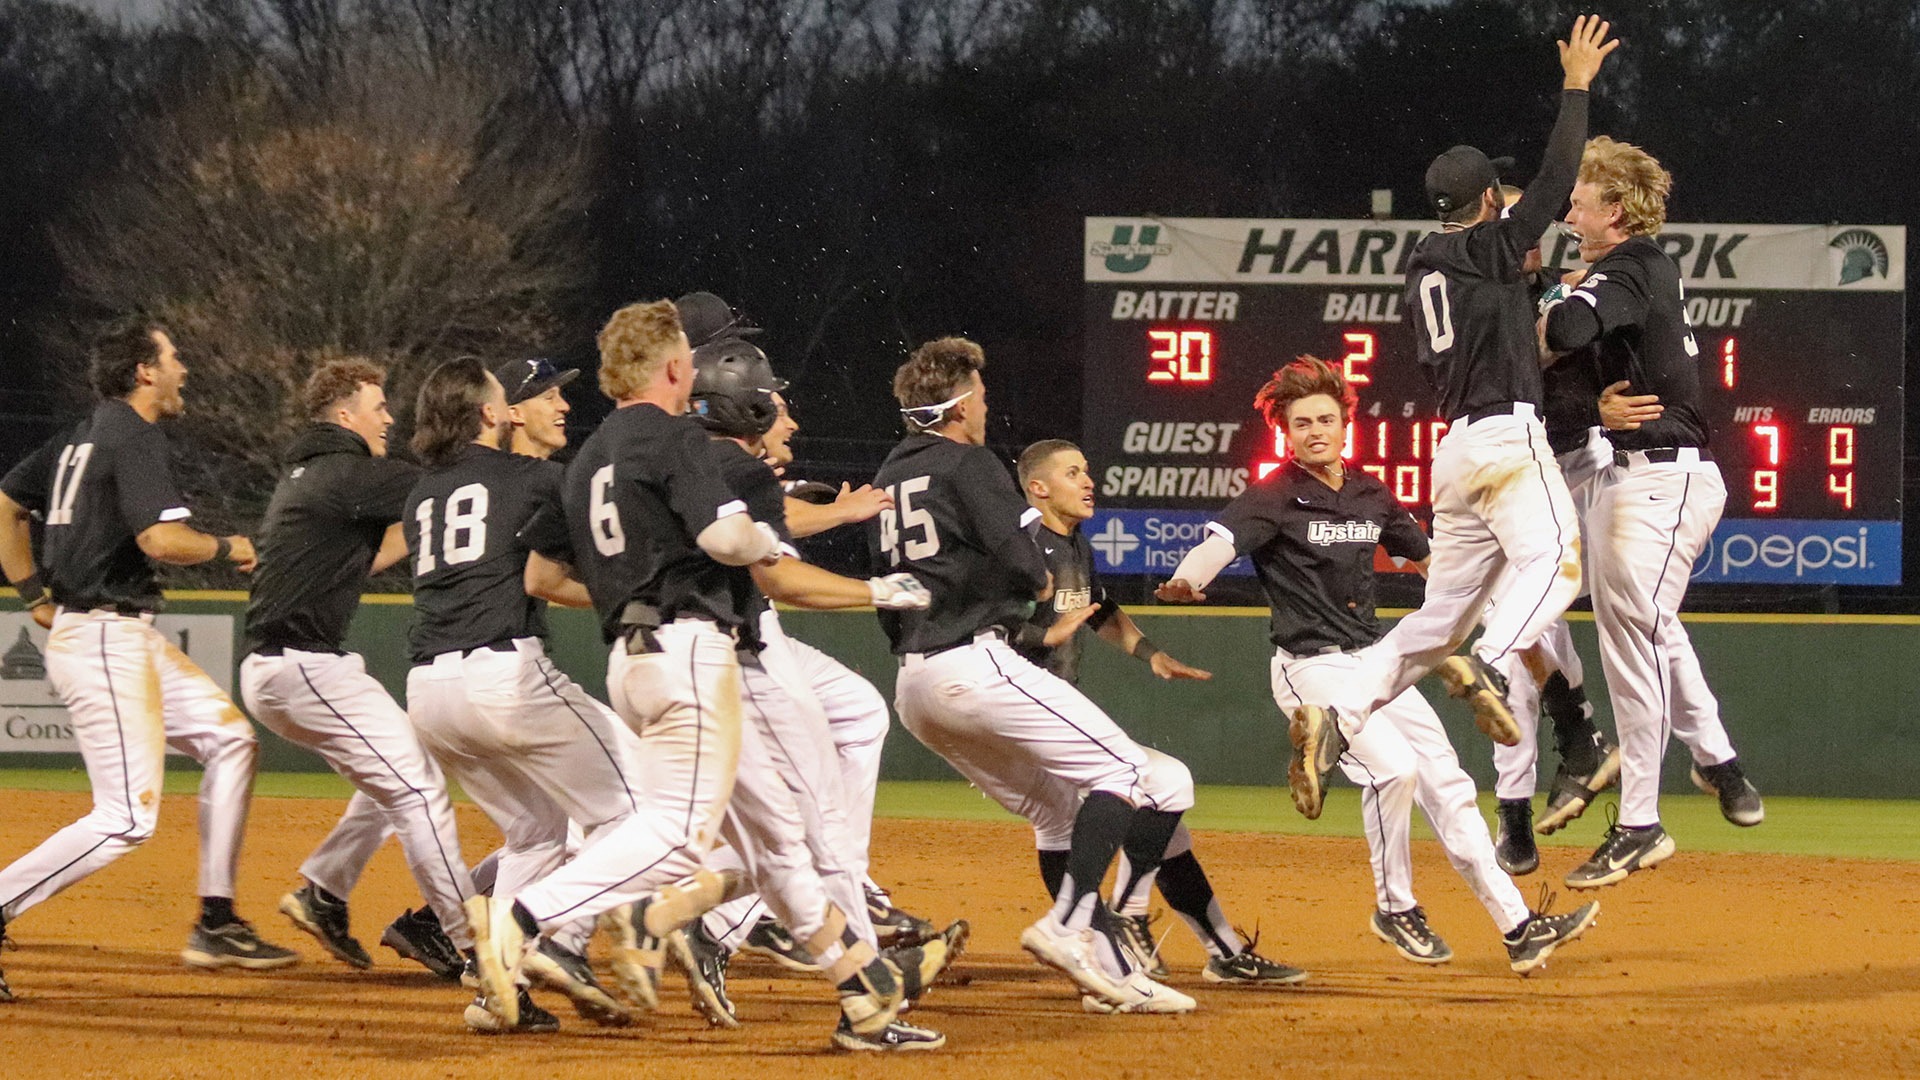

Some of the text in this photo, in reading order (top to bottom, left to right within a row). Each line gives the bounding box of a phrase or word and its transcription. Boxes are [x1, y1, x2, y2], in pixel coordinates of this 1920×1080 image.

[1549, 232, 1750, 279] PRK
[1111, 290, 1240, 320] BATTER
[1323, 293, 1402, 322] BALL
[1420, 270, 1455, 353] 0
[1688, 297, 1753, 327] OUT
[1148, 330, 1211, 381] 30
[1343, 333, 1373, 382] 2
[1724, 338, 1735, 388] 1
[1369, 402, 1415, 418] 4 5
[1733, 407, 1774, 422] HITS
[1808, 407, 1876, 424] ERRORS
[1123, 422, 1240, 454] GUEST
[1754, 426, 1854, 465] 7 0
[46, 442, 94, 525] 17
[1102, 466, 1250, 498] SPARTANS
[1754, 471, 1853, 509] 9 4
[590, 463, 626, 557] 6
[880, 475, 940, 567] 45
[415, 482, 489, 577] 18
[1145, 517, 1209, 544] Spor
[1308, 520, 1382, 546] Upstate
[1145, 545, 1193, 567] Inst
[1722, 527, 1868, 576] pepsi
